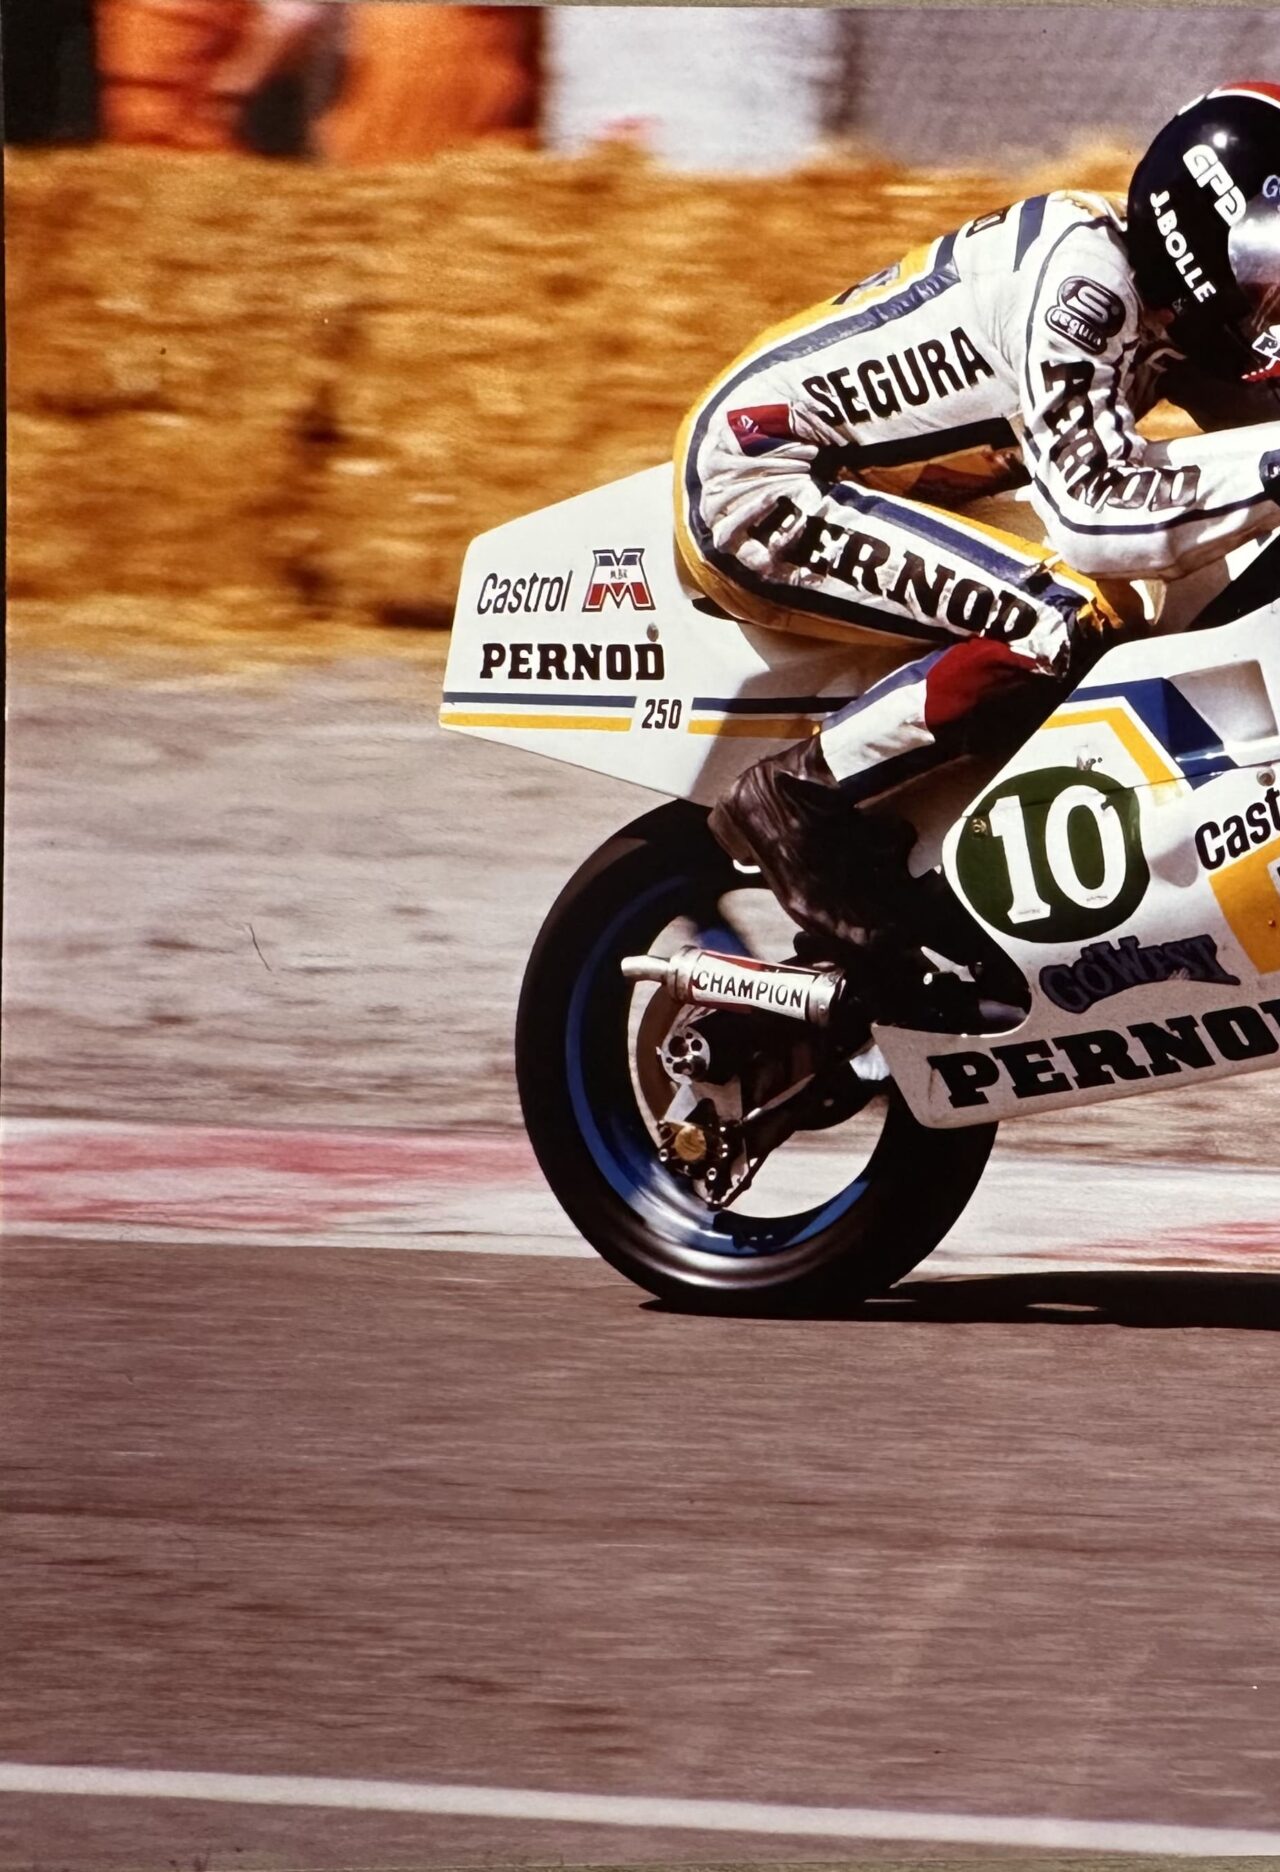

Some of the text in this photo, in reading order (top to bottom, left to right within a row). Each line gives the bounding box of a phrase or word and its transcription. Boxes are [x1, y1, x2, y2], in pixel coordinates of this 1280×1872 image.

[801, 326, 995, 425] SEGURA
[476, 570, 573, 615] Castrol
[479, 642, 665, 681] PERNOD
[641, 698, 682, 730] 250
[988, 783, 1128, 924] 10
[696, 970, 803, 1008] CHAMPION
